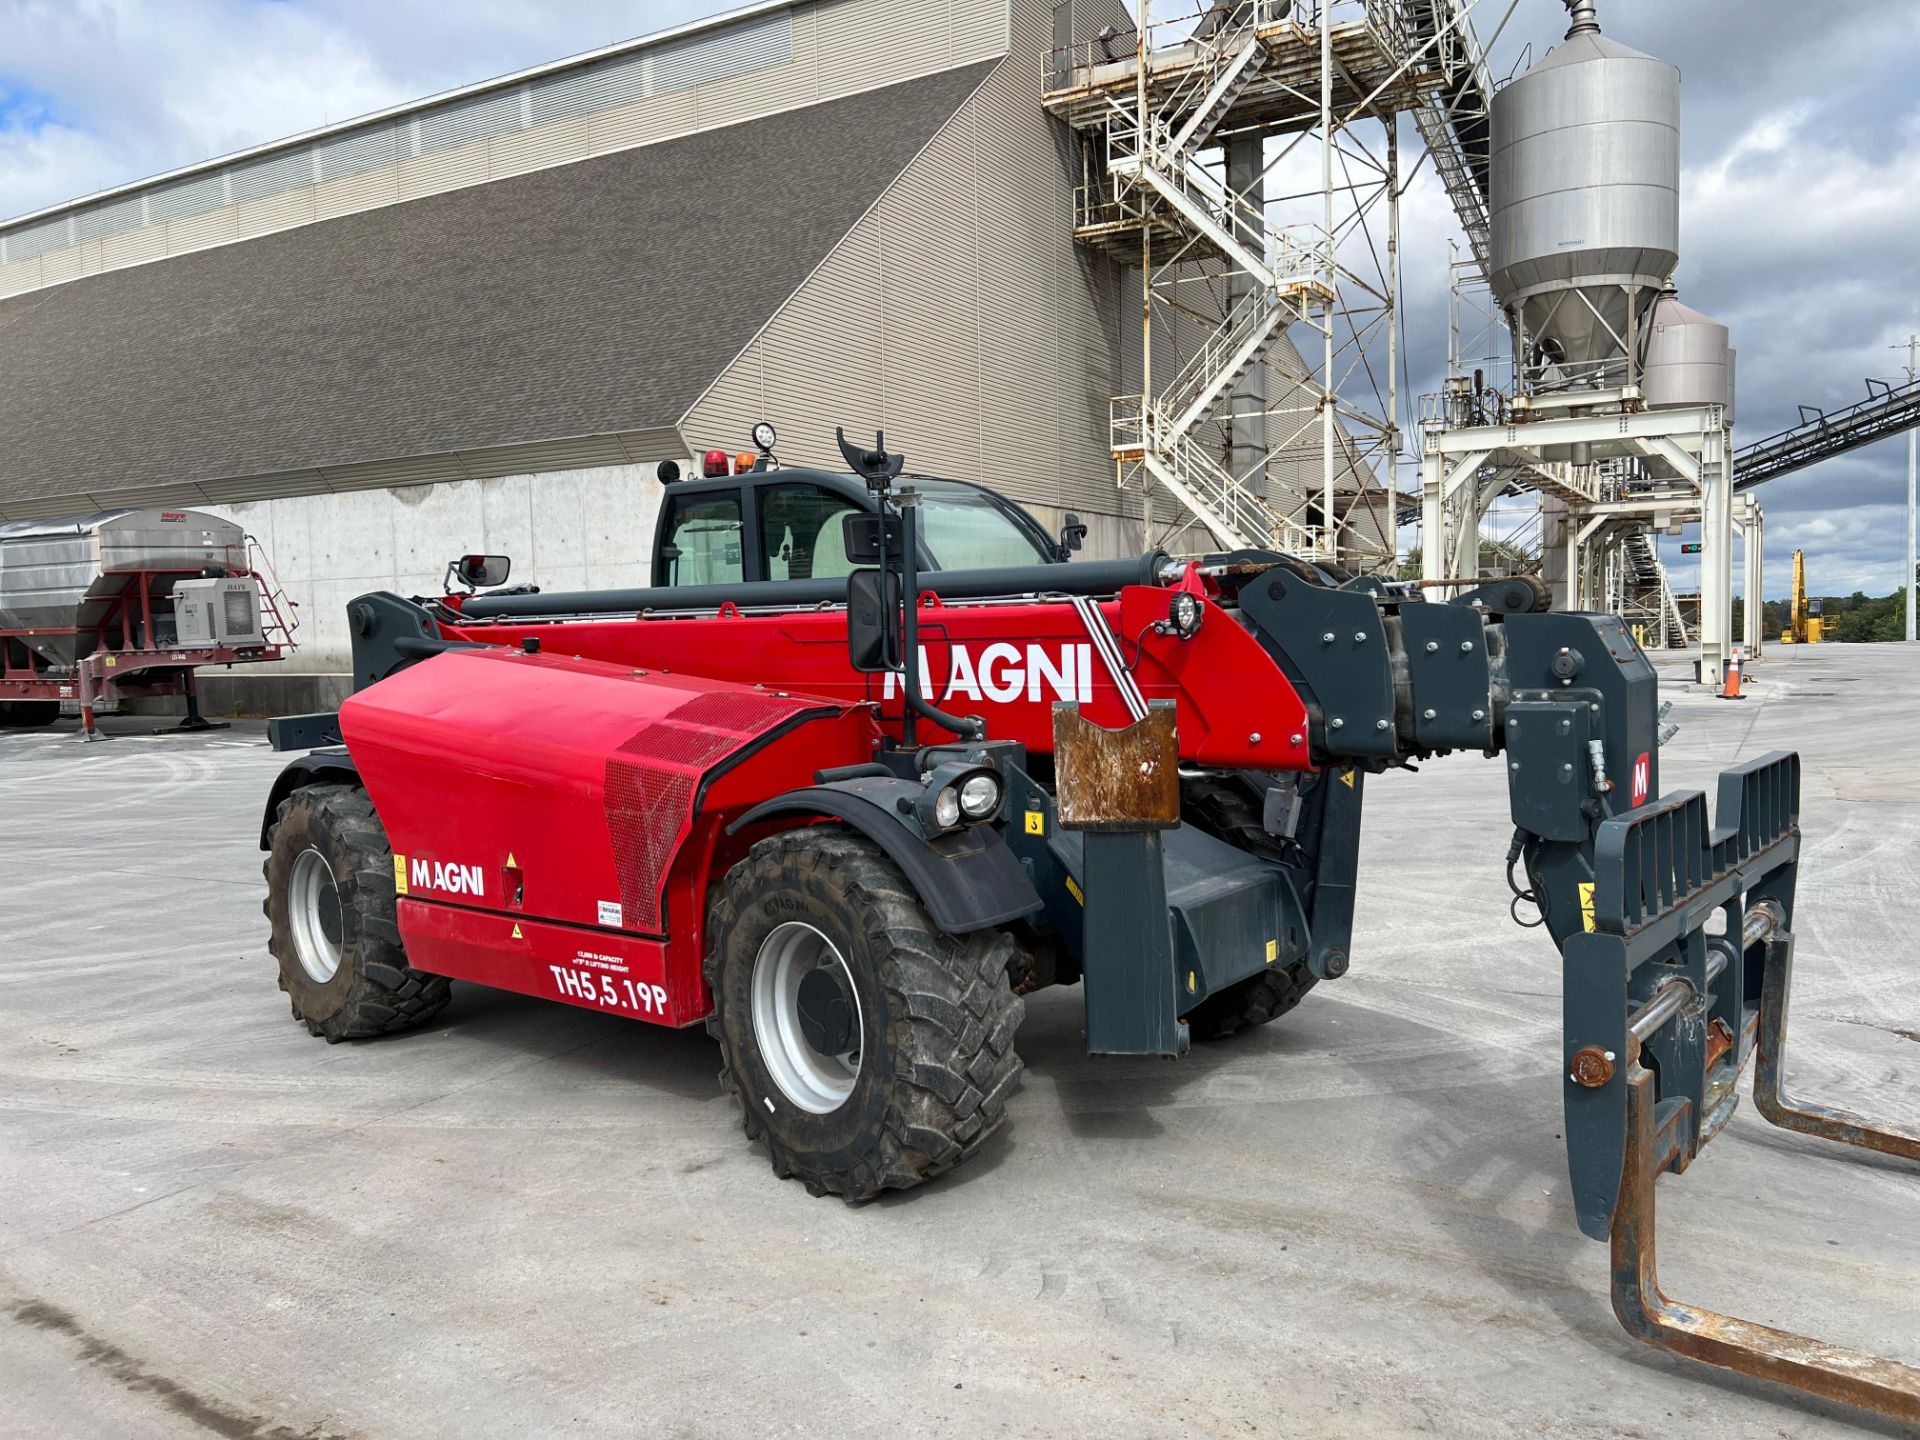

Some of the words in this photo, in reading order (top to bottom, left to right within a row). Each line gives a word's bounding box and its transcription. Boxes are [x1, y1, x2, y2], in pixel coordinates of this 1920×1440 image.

[1634, 761, 1647, 798] M
[412, 858, 484, 896] MAGNI
[764, 895, 809, 916] MAGNI
[599, 954, 623, 964] CAPACITY
[549, 965, 667, 1015] TH5,5.19P
